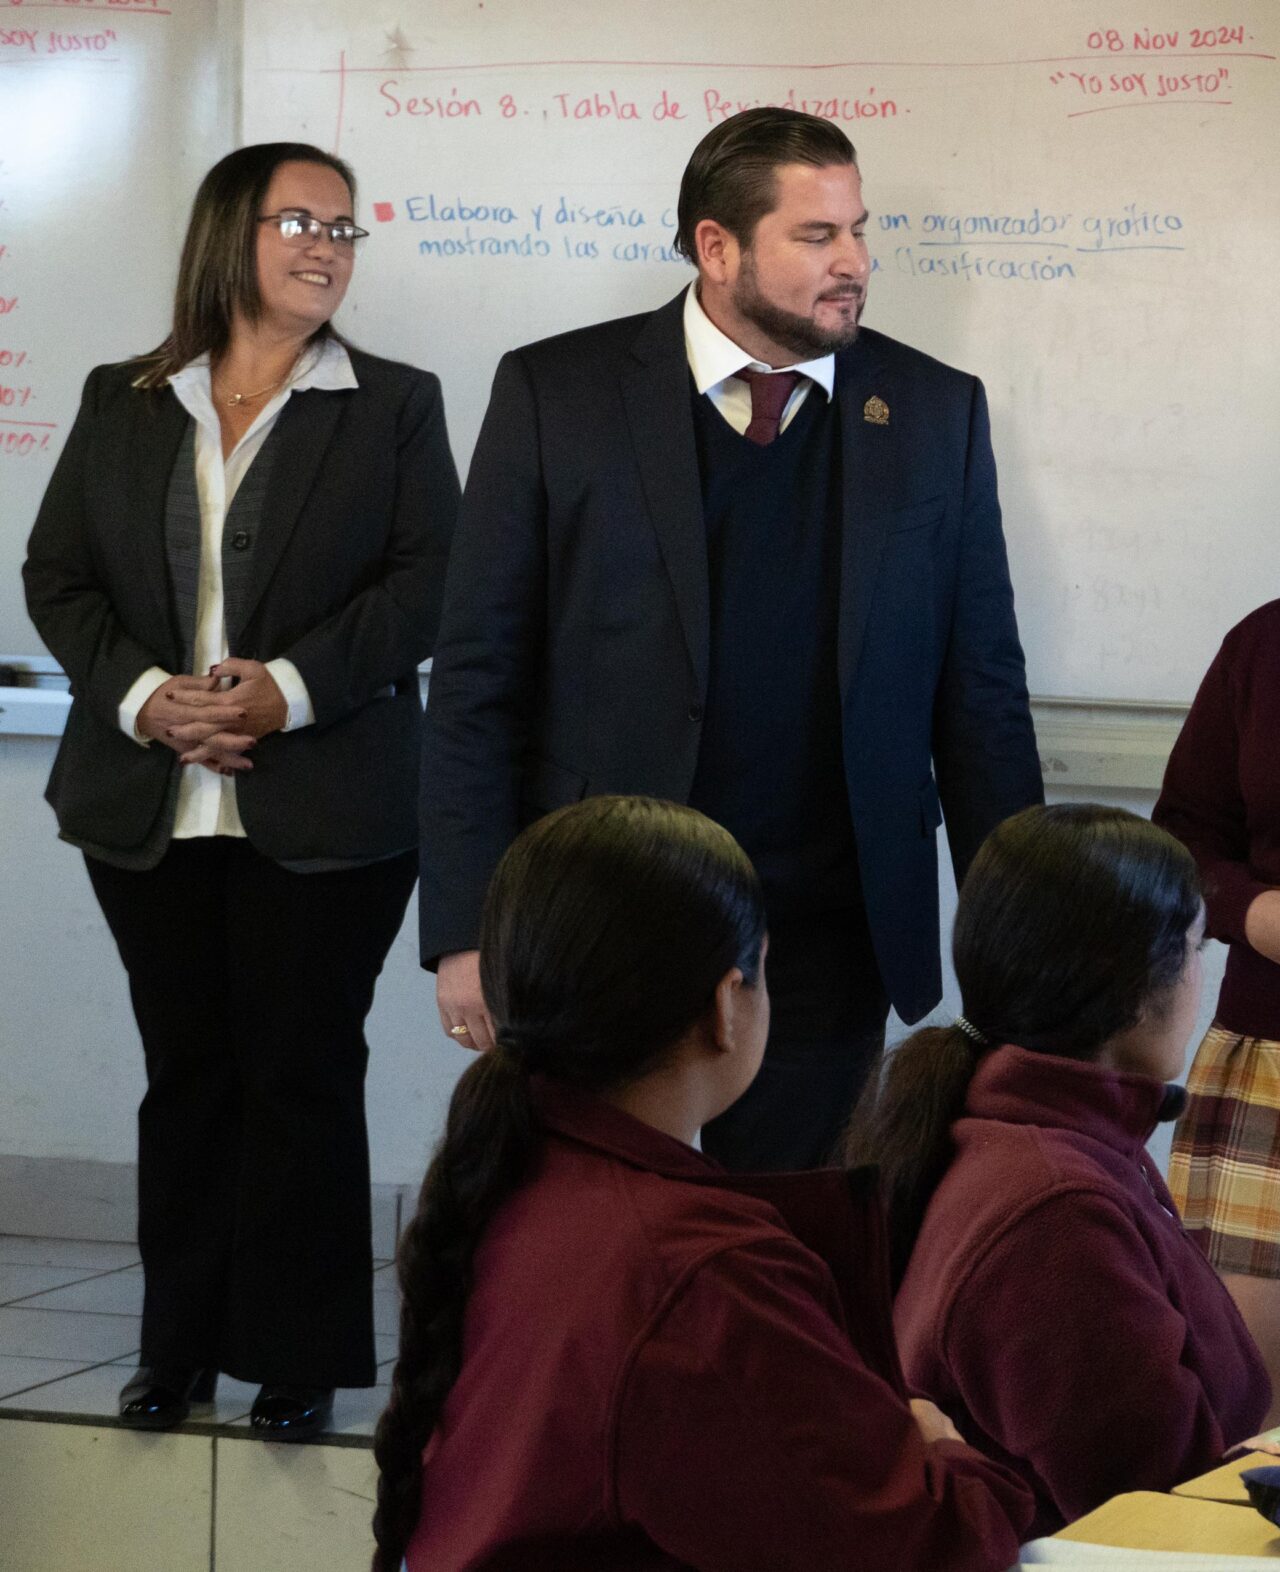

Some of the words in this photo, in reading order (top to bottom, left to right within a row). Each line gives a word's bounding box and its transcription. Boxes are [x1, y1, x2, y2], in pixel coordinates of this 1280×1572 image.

[1087, 29, 1124, 51] 08
[380, 80, 482, 118] Sesión
[652, 91, 688, 120] de
[406, 195, 517, 223] Elabora
[879, 214, 909, 232] un
[921, 208, 1072, 244] organizador
[419, 227, 550, 257] mostrando
[565, 236, 599, 259] las
